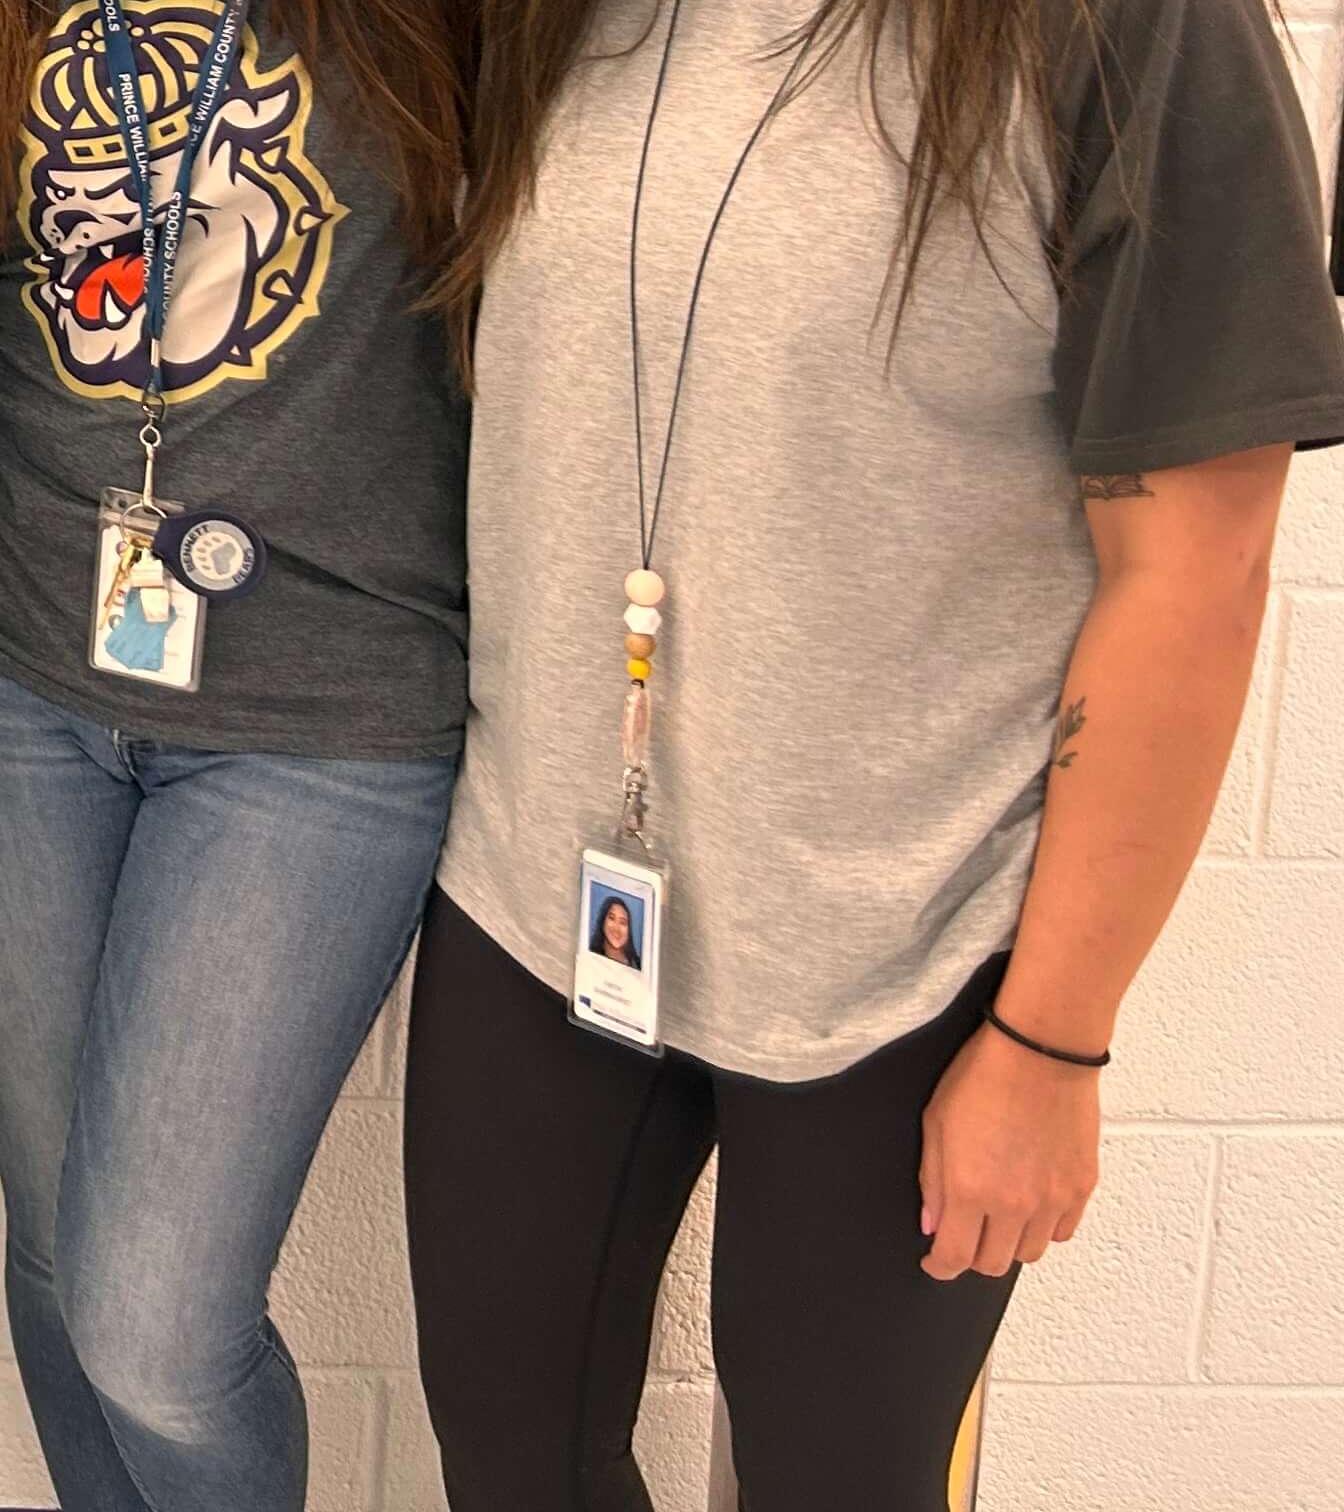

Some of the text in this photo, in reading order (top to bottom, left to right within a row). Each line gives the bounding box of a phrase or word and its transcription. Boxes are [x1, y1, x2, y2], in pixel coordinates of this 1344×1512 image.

[118, 72, 141, 125] PRINCE
[194, 64, 224, 122] WILLIAM
[214, 7, 238, 64] COUNTY
[164, 191, 183, 260] SCHOOLS
